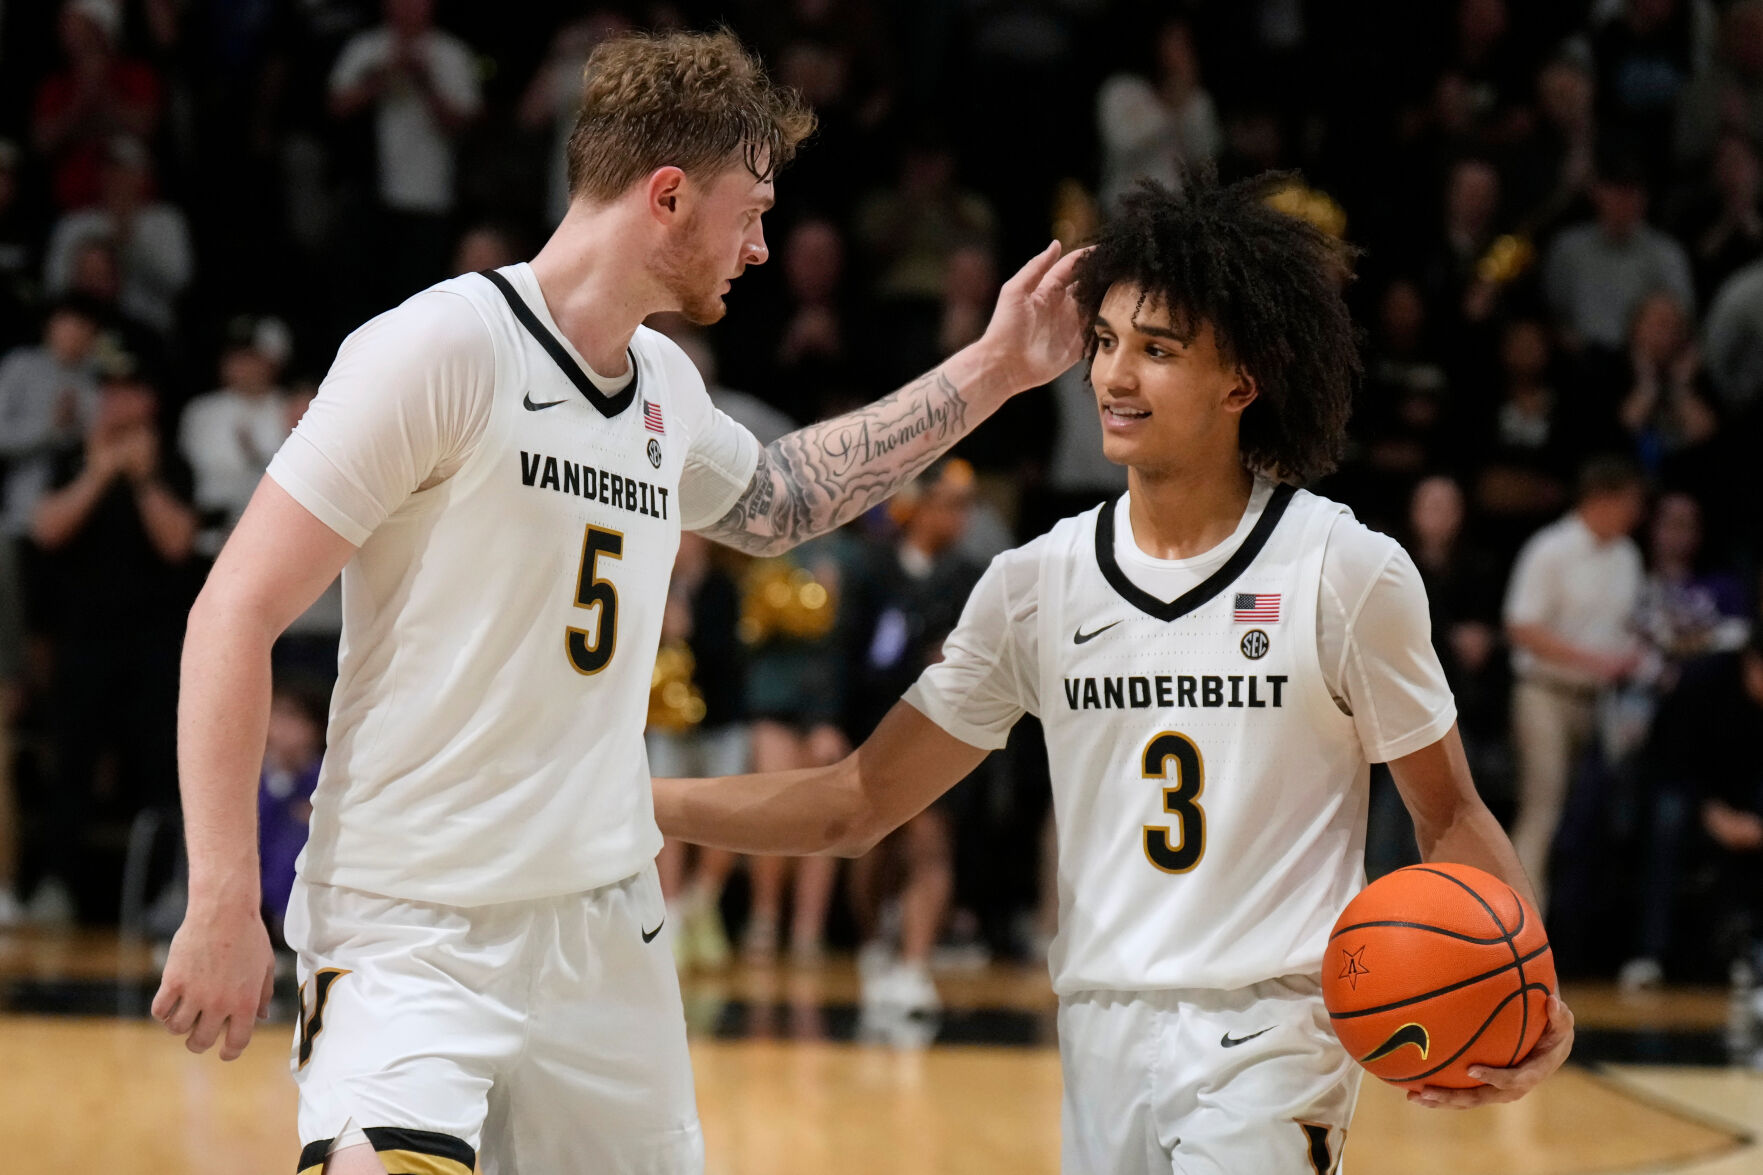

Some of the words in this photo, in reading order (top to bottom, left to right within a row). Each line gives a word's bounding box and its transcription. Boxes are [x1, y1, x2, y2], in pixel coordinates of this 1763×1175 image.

[823, 392, 948, 476] Anomaly
[520, 451, 668, 520] VANDERBILT
[564, 523, 624, 676] 5
[1243, 631, 1267, 657] SEC
[1064, 675, 1288, 710] VANDERBILT
[1141, 730, 1206, 875] 3
